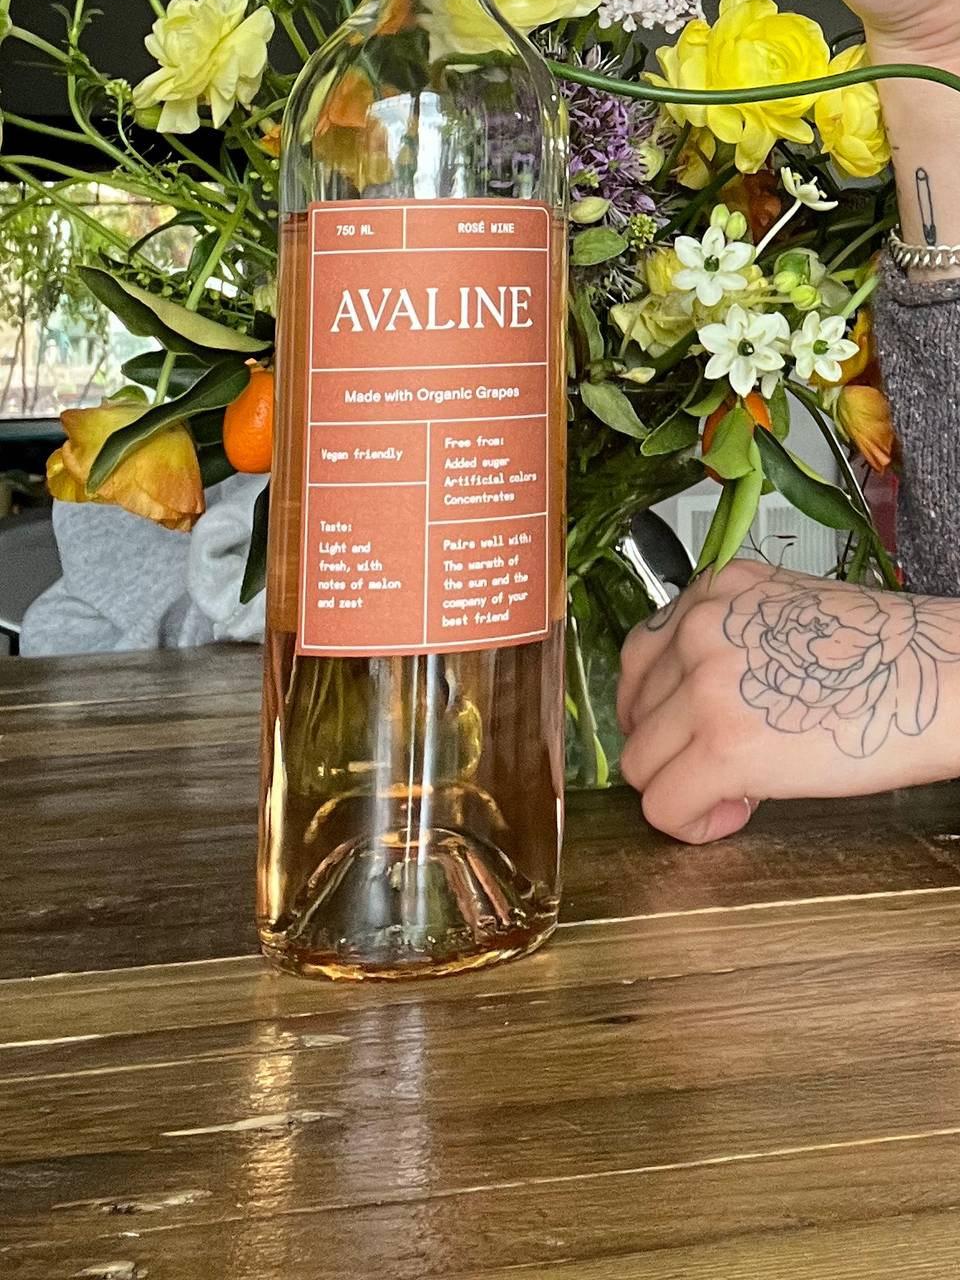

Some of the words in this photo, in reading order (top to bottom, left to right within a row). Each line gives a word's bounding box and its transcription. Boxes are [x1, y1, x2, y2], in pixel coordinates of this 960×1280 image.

[336, 225, 355, 236] 750
[361, 225, 374, 235] ML
[458, 221, 485, 233] ROSÉ
[491, 223, 515, 233] WINE
[330, 286, 533, 332] AVALINE
[345, 390, 381, 402] Made
[385, 388, 413, 402] with
[417, 387, 472, 403] Organic
[476, 386, 519, 400] Grapes
[445, 437, 471, 448] Free
[477, 436, 504, 447] from:
[321, 448, 348, 462] Vegan
[354, 448, 403, 461] friendly
[445, 457, 476, 469] Added
[482, 457, 510, 468] sugar
[444, 473, 504, 487] Artificial
[509, 472, 536, 484] colors
[444, 492, 515, 505] Concentrates
[320, 521, 352, 532] Taste:
[319, 542, 346, 555] Light
[352, 542, 370, 553] and
[443, 539, 475, 551] Pairs
[480, 536, 504, 548] well
[509, 534, 532, 545] with:
[319, 561, 350, 572] fresh,
[357, 561, 382, 571] with
[444, 561, 463, 571] The
[468, 558, 504, 570] warmth
[509, 555, 519, 566] of
[318, 579, 345, 590] notes
[351, 578, 363, 589] of
[368, 579, 401, 589] melon
[444, 579, 463, 590] the
[468, 579, 487, 588] sun
[492, 575, 509, 586] and
[514, 573, 529, 583] the
[318, 597, 334, 608] and
[339, 598, 363, 608] zest
[443, 595, 487, 609] company
[491, 593, 503, 605] of
[508, 592, 528, 605] your
[442, 615, 468, 627] best
[474, 610, 509, 624] friend
